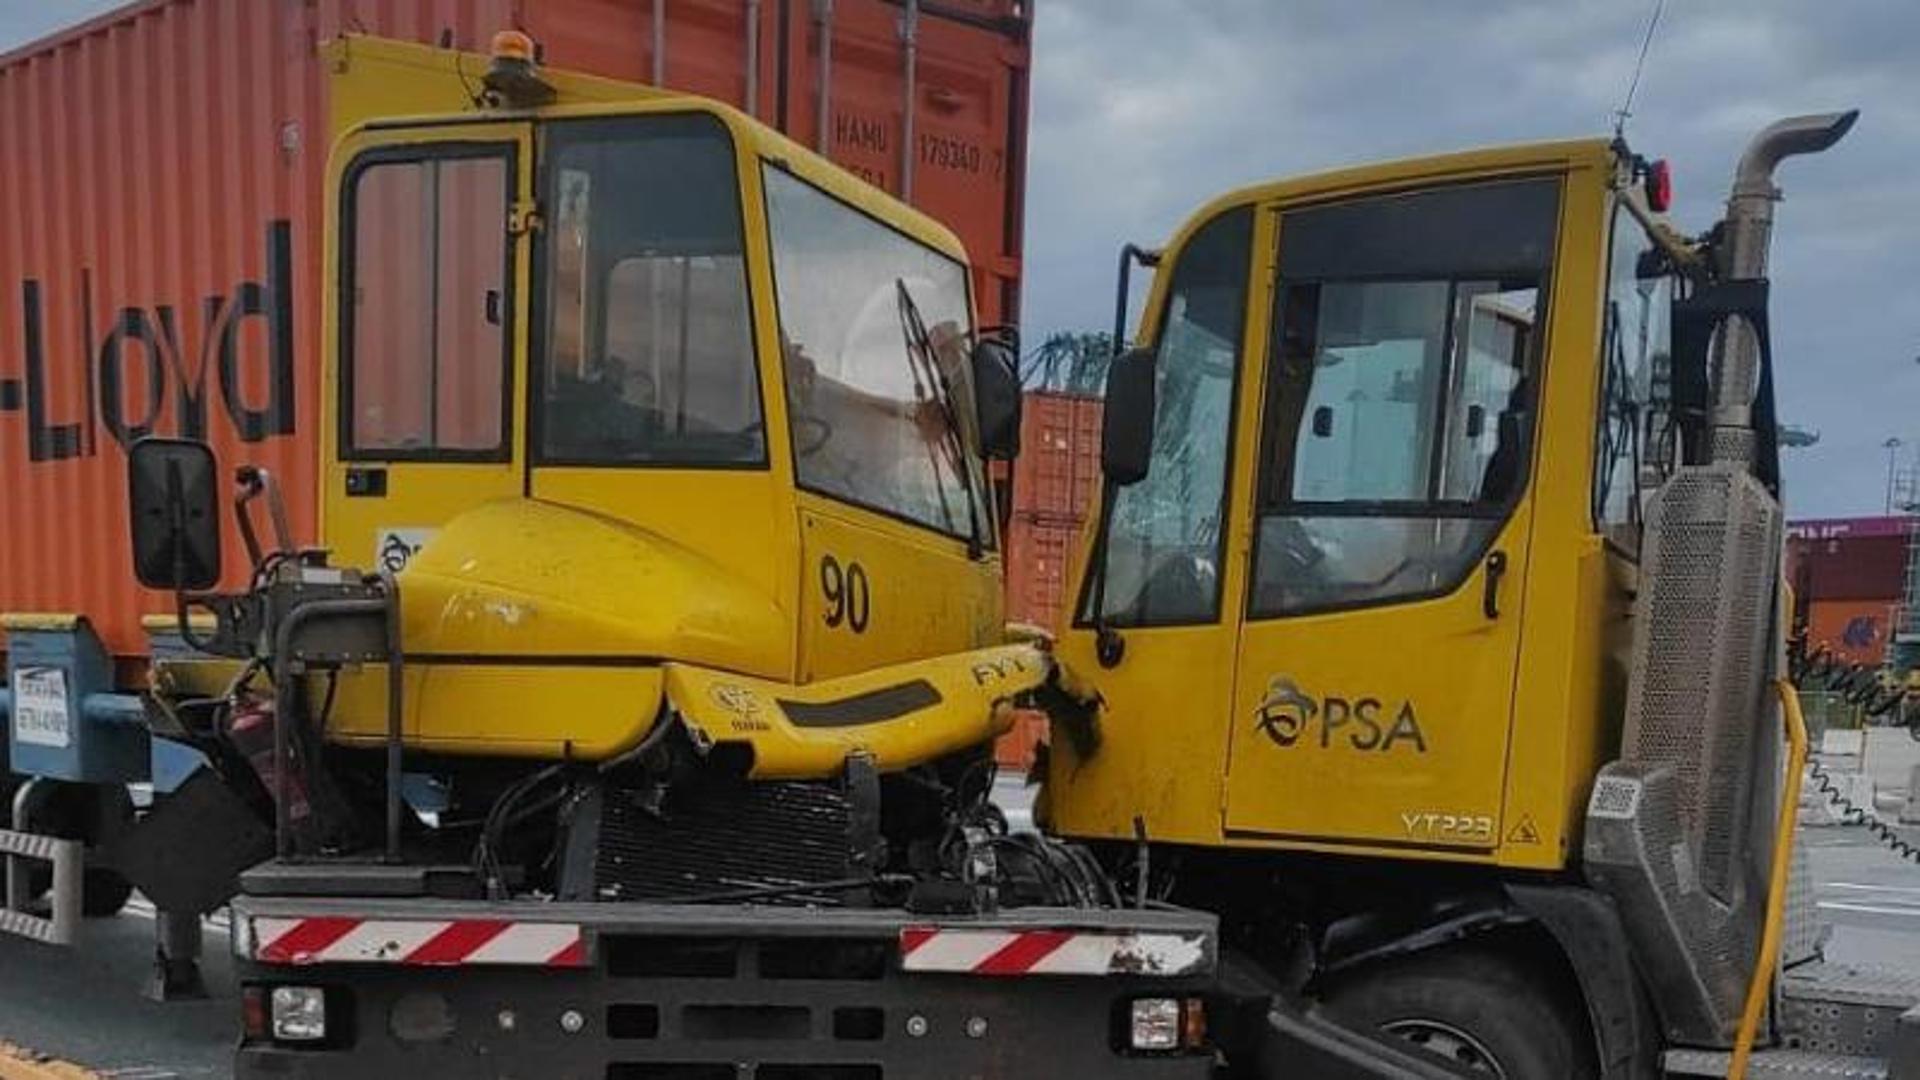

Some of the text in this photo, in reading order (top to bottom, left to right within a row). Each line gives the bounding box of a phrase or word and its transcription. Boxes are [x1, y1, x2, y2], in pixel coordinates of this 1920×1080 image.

[837, 113, 886, 152] HAMU
[821, 553, 870, 635] 90
[1319, 697, 1427, 752] PSA
[1400, 812, 1493, 835] YT223
